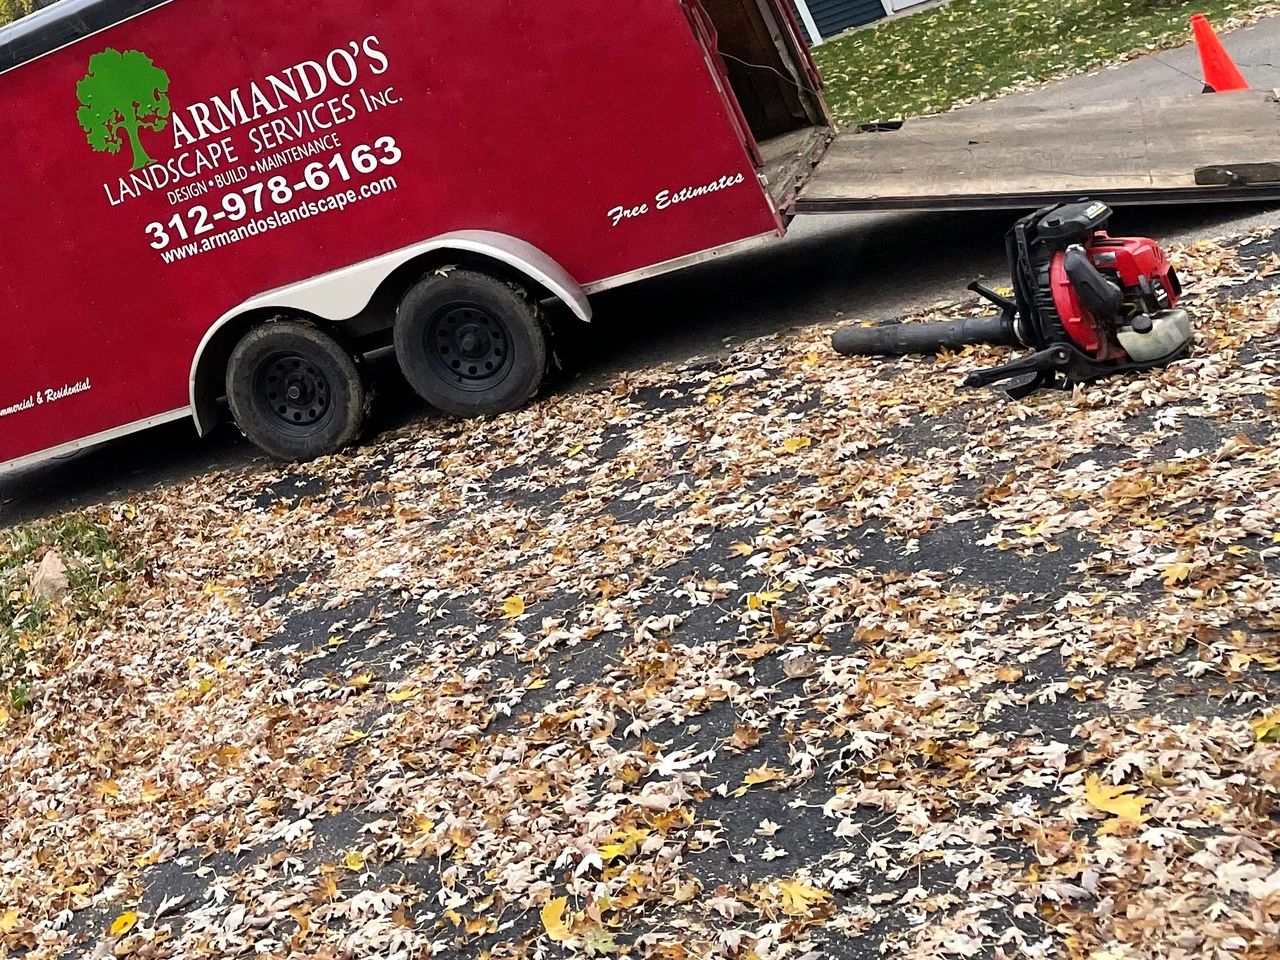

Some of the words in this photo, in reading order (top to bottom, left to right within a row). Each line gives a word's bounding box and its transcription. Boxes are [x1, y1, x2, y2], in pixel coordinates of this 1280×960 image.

[170, 35, 389, 149] ARMANDO'S
[103, 137, 239, 207] LANDSCAPE
[249, 93, 357, 153] SERVICES
[144, 136, 403, 250] 312-978-6163
[167, 179, 209, 205] DESIGN
[215, 164, 248, 189] BUILD
[257, 132, 342, 175] MAINTENANCE
[161, 175, 398, 264] www.armandoslandscape.com
[607, 203, 649, 227] Free
[655, 172, 745, 210] Estimates
[36, 391, 43, 405] &
[44, 376, 92, 402] Residential
